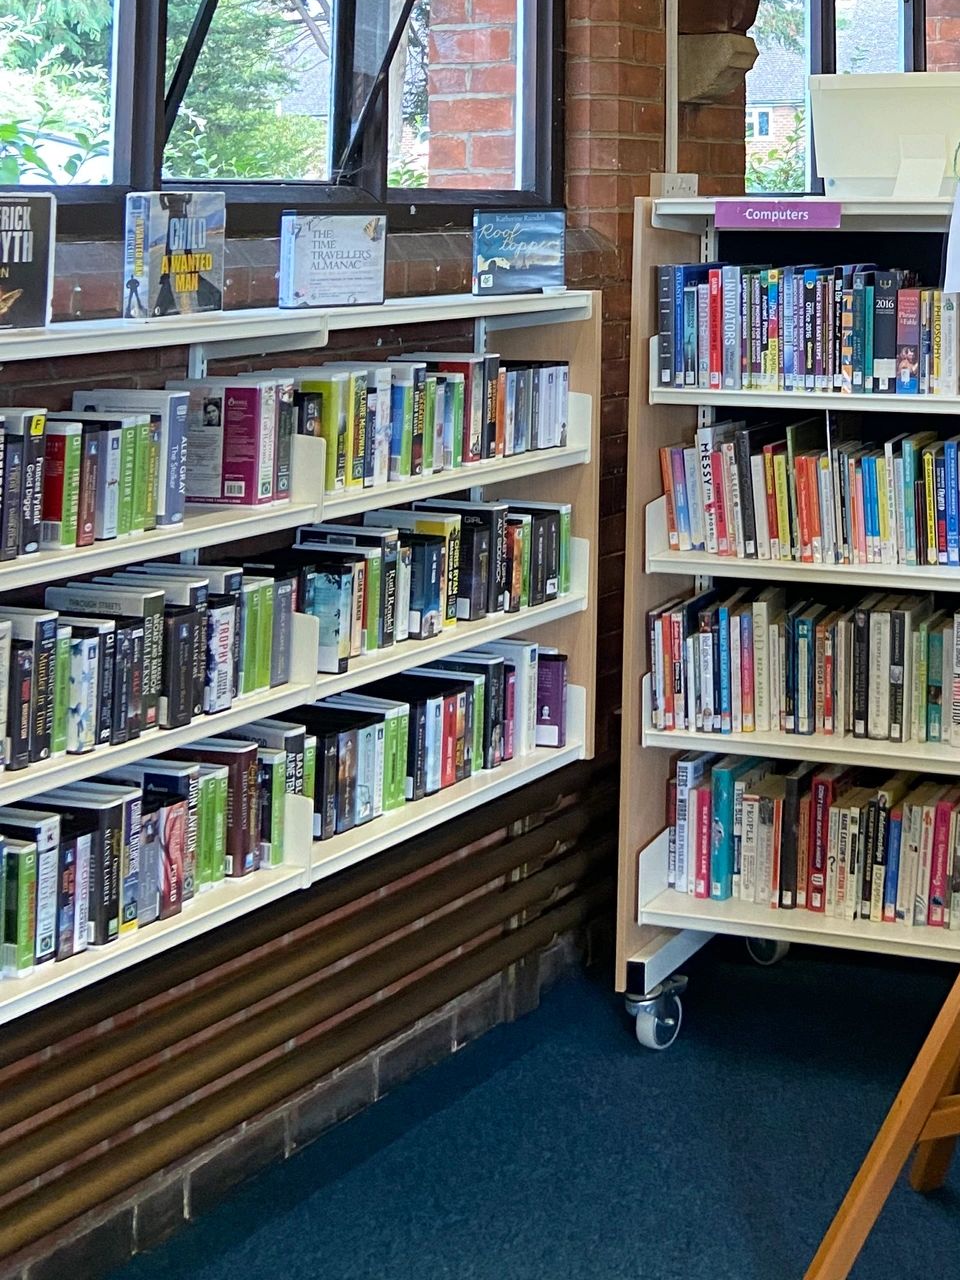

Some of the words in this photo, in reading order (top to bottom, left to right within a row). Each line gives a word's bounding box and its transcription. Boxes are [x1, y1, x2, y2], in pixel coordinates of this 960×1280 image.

[745, 208, 809, 222] Computers
[169, 217, 207, 250] CHILD
[311, 240, 336, 249] TIME
[312, 229, 334, 238] THE
[161, 255, 168, 275] A
[170, 253, 212, 273] WANTED
[310, 260, 362, 270] ALMANAC
[175, 272, 199, 292] MAN
[725, 279, 735, 345] INNOVATORS
[769, 301, 777, 320] iPad
[876, 299, 894, 308] 2016
[26, 464, 34, 488] Gold
[34, 457, 43, 492] Frances
[170, 462, 178, 489] Stalker
[700, 443, 712, 485] MESSY
[23, 489, 33, 520] Digger
[387, 569, 396, 595] Ruth
[386, 597, 395, 633] Rendell
[218, 620, 230, 665] TROPHY
[754, 613, 765, 650] GOD
[700, 635, 711, 672] Religions
[37, 652, 48, 690] Murder
[816, 664, 824, 685] ROAD
[37, 694, 47, 706] in
[20, 703, 28, 739] BRIGHTON
[36, 710, 47, 736] Time
[286, 752, 295, 776] ALINE
[295, 752, 304, 776] BAD
[678, 766, 688, 787] DEEDS
[188, 778, 198, 807] JOHN
[735, 788, 743, 806] TRUE
[130, 801, 141, 834] CRIMINAL
[677, 798, 687, 822] WORDS
[734, 808, 743, 826] BLUE
[840, 813, 848, 831] MARK
[187, 808, 198, 852] LAWTON
[702, 825, 707, 834] IN
[745, 803, 754, 844] PEOPLE
[875, 810, 886, 862] Relationships
[103, 829, 111, 867] SUZANNE
[128, 835, 141, 876] ENTERPRISE
[840, 832, 848, 856] EASTON
[170, 863, 178, 902] PURGED
